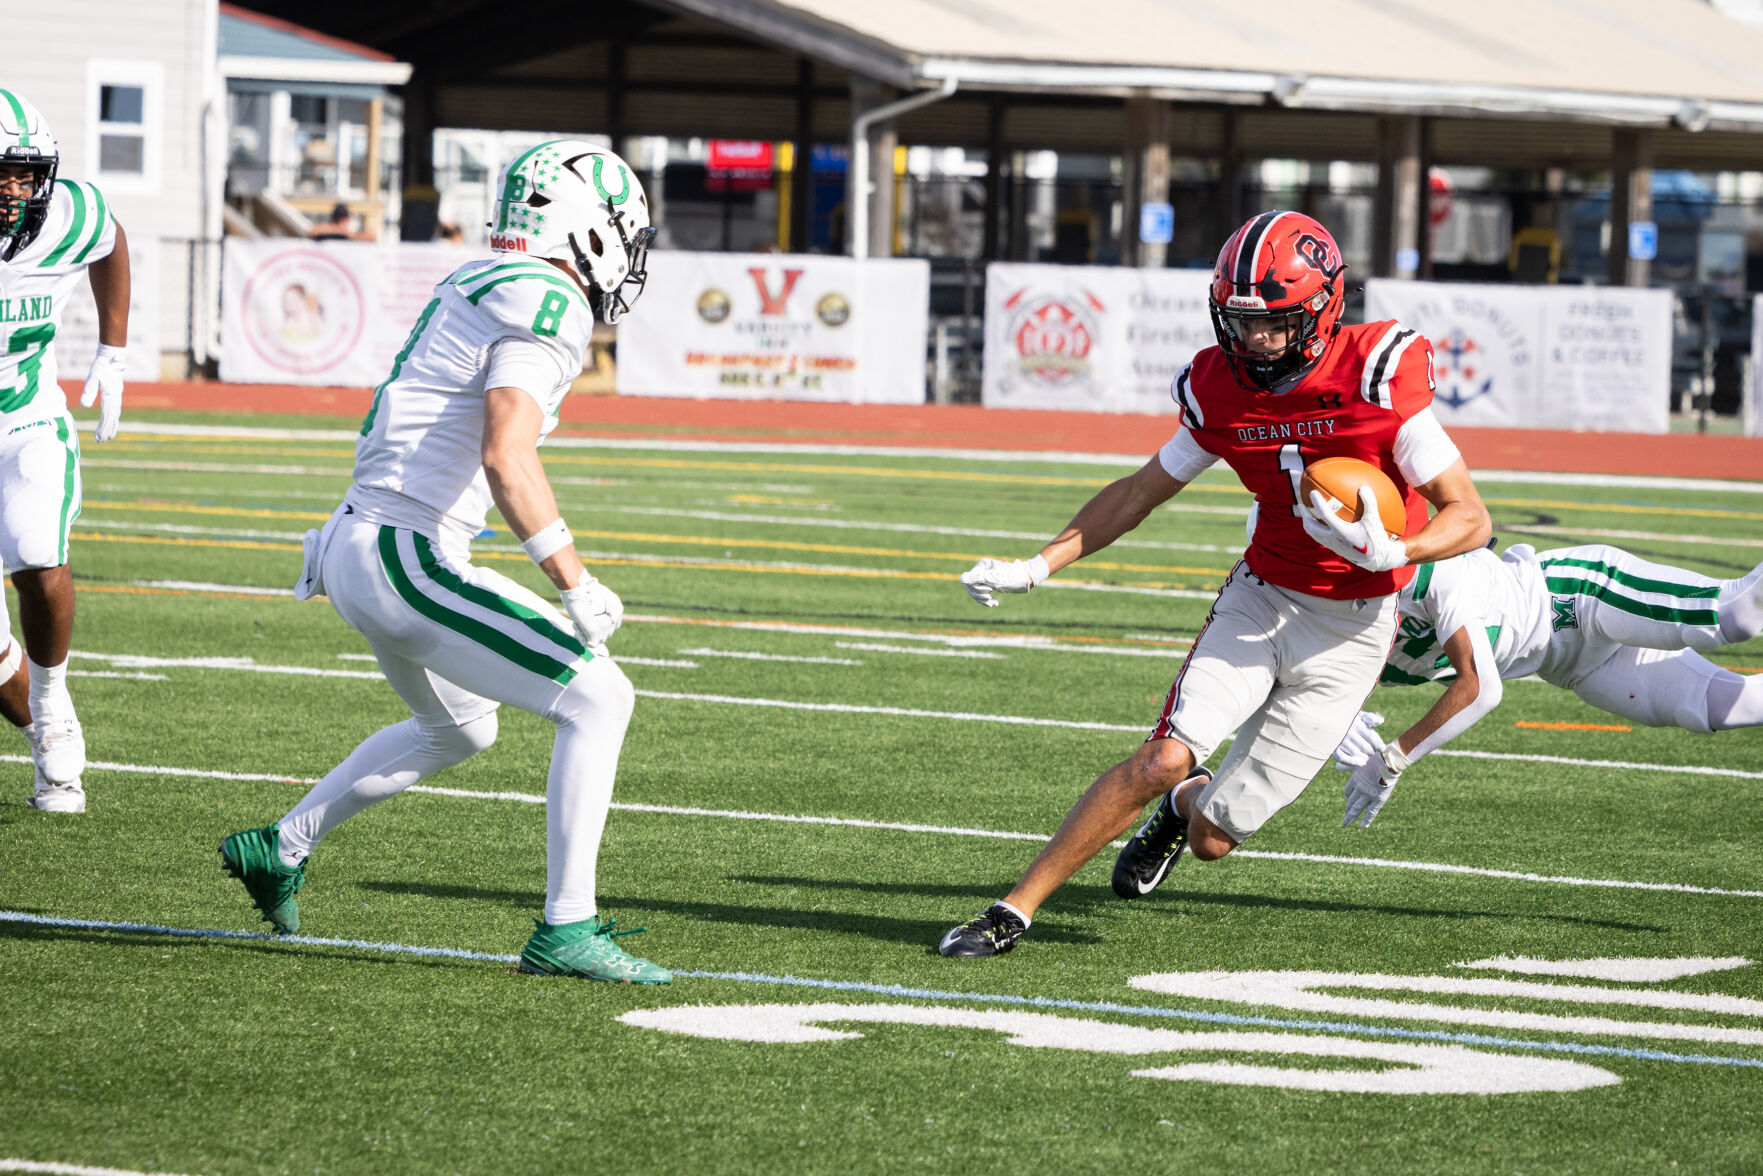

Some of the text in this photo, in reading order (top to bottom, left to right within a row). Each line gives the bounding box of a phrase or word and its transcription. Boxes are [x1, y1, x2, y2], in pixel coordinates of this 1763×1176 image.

[10, 146, 38, 155] Riddell
[747, 268, 805, 315] V
[1229, 299, 1259, 308] Riddell
[531, 289, 570, 337] 8
[1237, 419, 1335, 442] OCEAN CITY
[1277, 441, 1308, 519] 1
[1550, 595, 1580, 633] M
